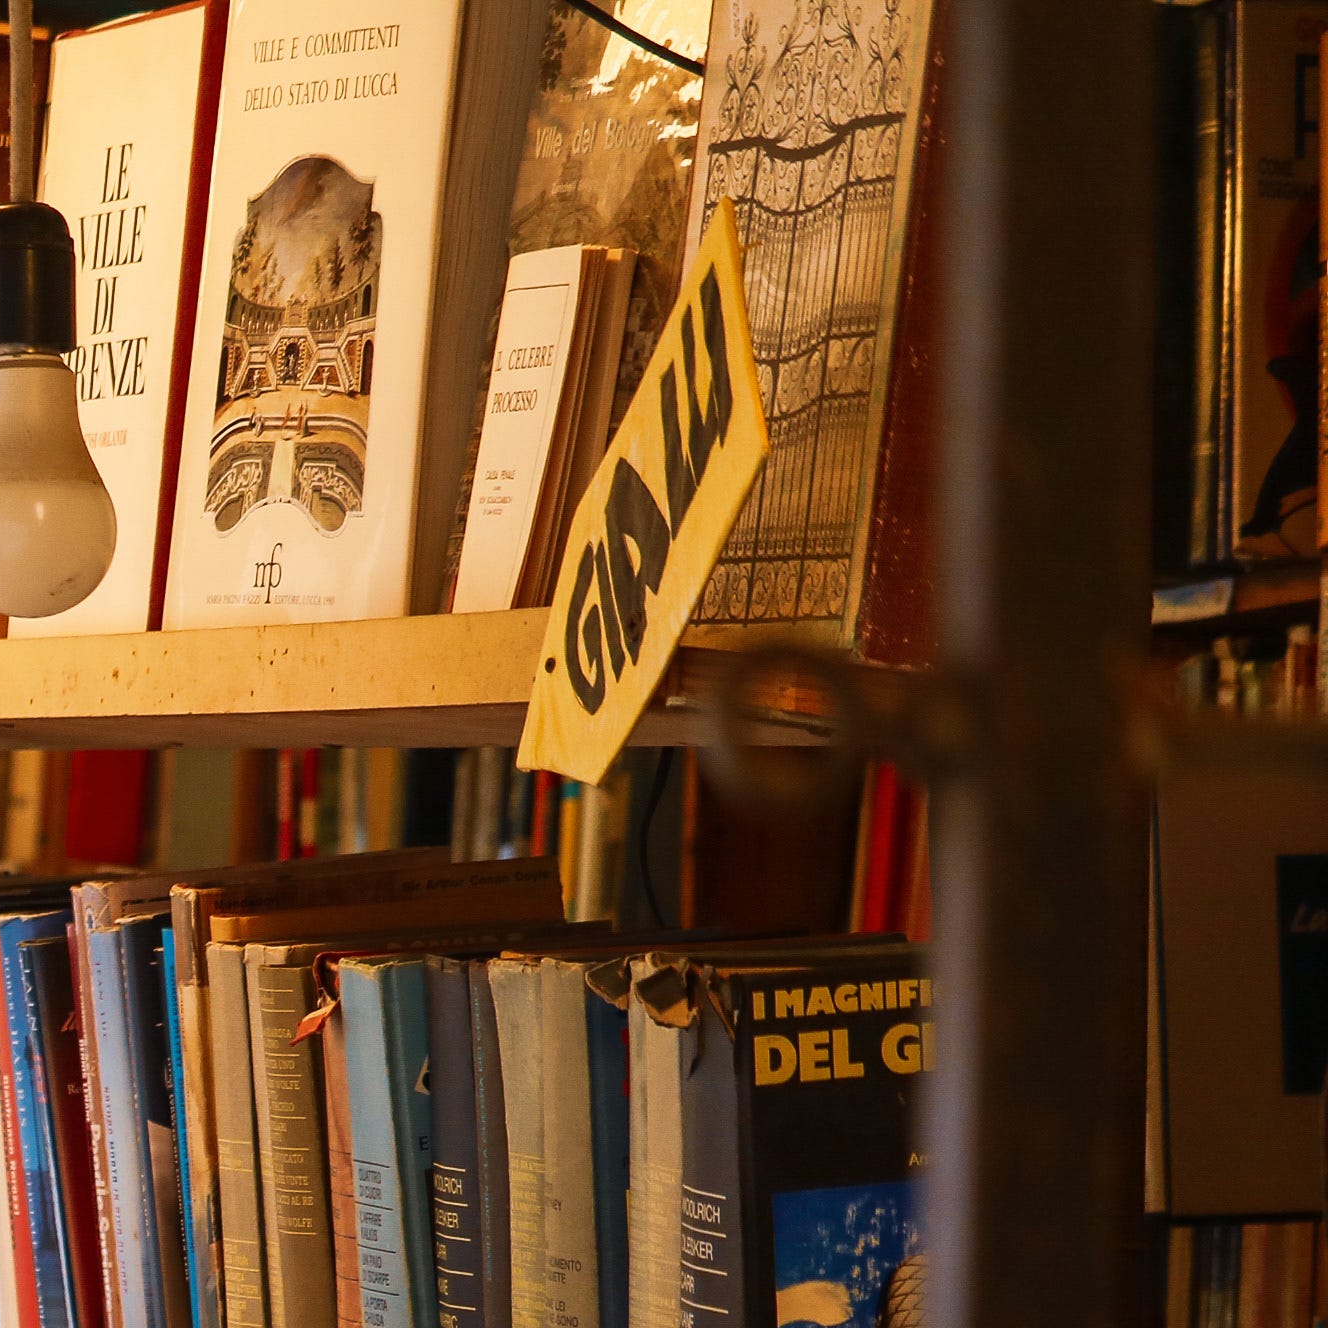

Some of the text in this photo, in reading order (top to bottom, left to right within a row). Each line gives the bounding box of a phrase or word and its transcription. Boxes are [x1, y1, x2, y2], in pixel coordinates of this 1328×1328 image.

[254, 24, 400, 64] VILLE E COMMITTENTI
[244, 72, 398, 112] DELLO STATO DI LUCCA
[536, 120, 598, 158] Ville del
[102, 144, 133, 203] LE
[79, 205, 146, 272] VILLE
[91, 276, 118, 335] DI
[63, 337, 148, 402] IRENZE
[495, 346, 554, 372] IL CELEBRE
[492, 389, 538, 414] PROCESSO
[752, 992, 765, 1021] I
[10, 1029, 28, 1128] HARRIS
[754, 1029, 864, 1086] DEL
